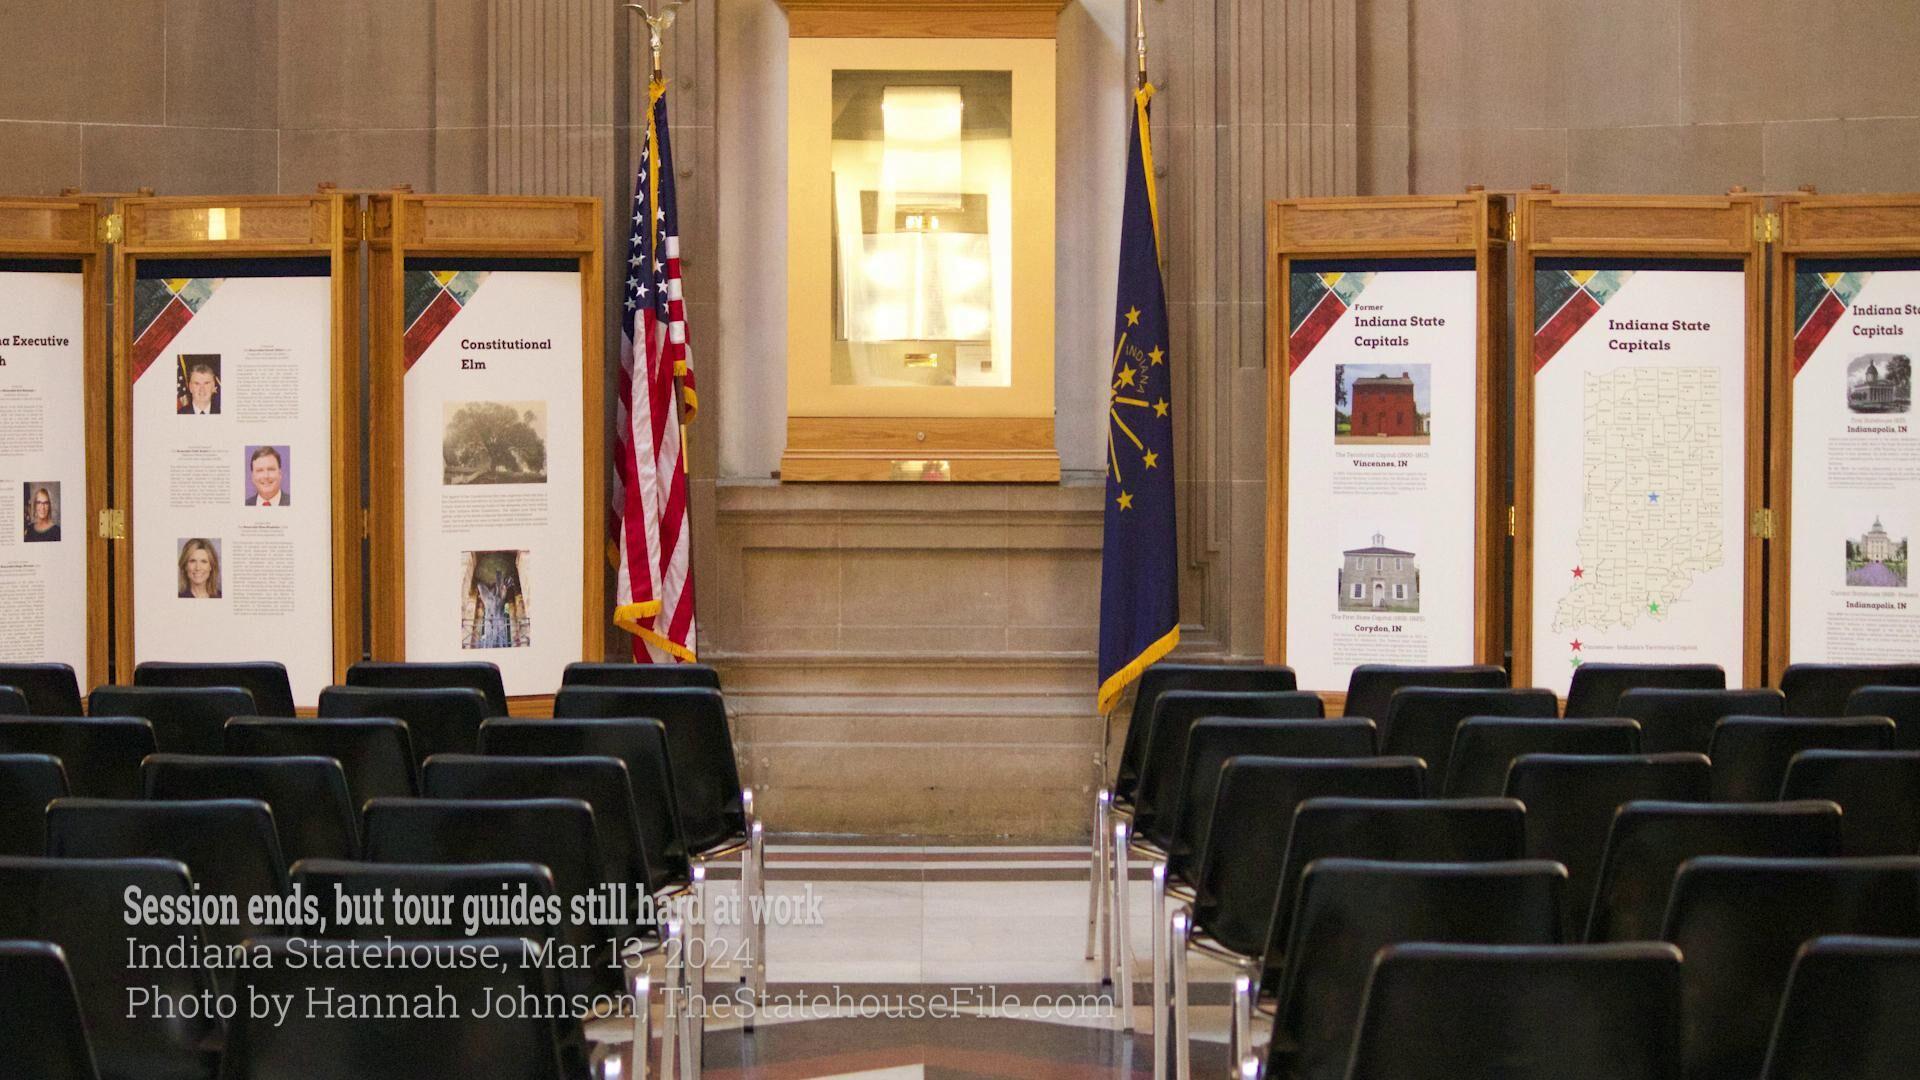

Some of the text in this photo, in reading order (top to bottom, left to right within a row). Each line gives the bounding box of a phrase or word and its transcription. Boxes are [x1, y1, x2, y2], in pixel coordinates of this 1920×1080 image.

[1355, 303, 1383, 311] Former
[1852, 304, 1902, 316] Indiana
[1354, 316, 1446, 327] Indiana State
[1608, 319, 1711, 331] Indiana State
[1852, 324, 1904, 339] Capitals
[12, 335, 70, 347] Executive
[460, 338, 552, 350] Constitutional
[1354, 335, 1409, 350] Capitals
[1608, 339, 1671, 353] Capitals
[460, 358, 487, 370] Elm
[1126, 345, 1149, 393] INDIANA
[1353, 460, 1396, 468] Vincennes,
[1354, 624, 1390, 633] Corydon,
